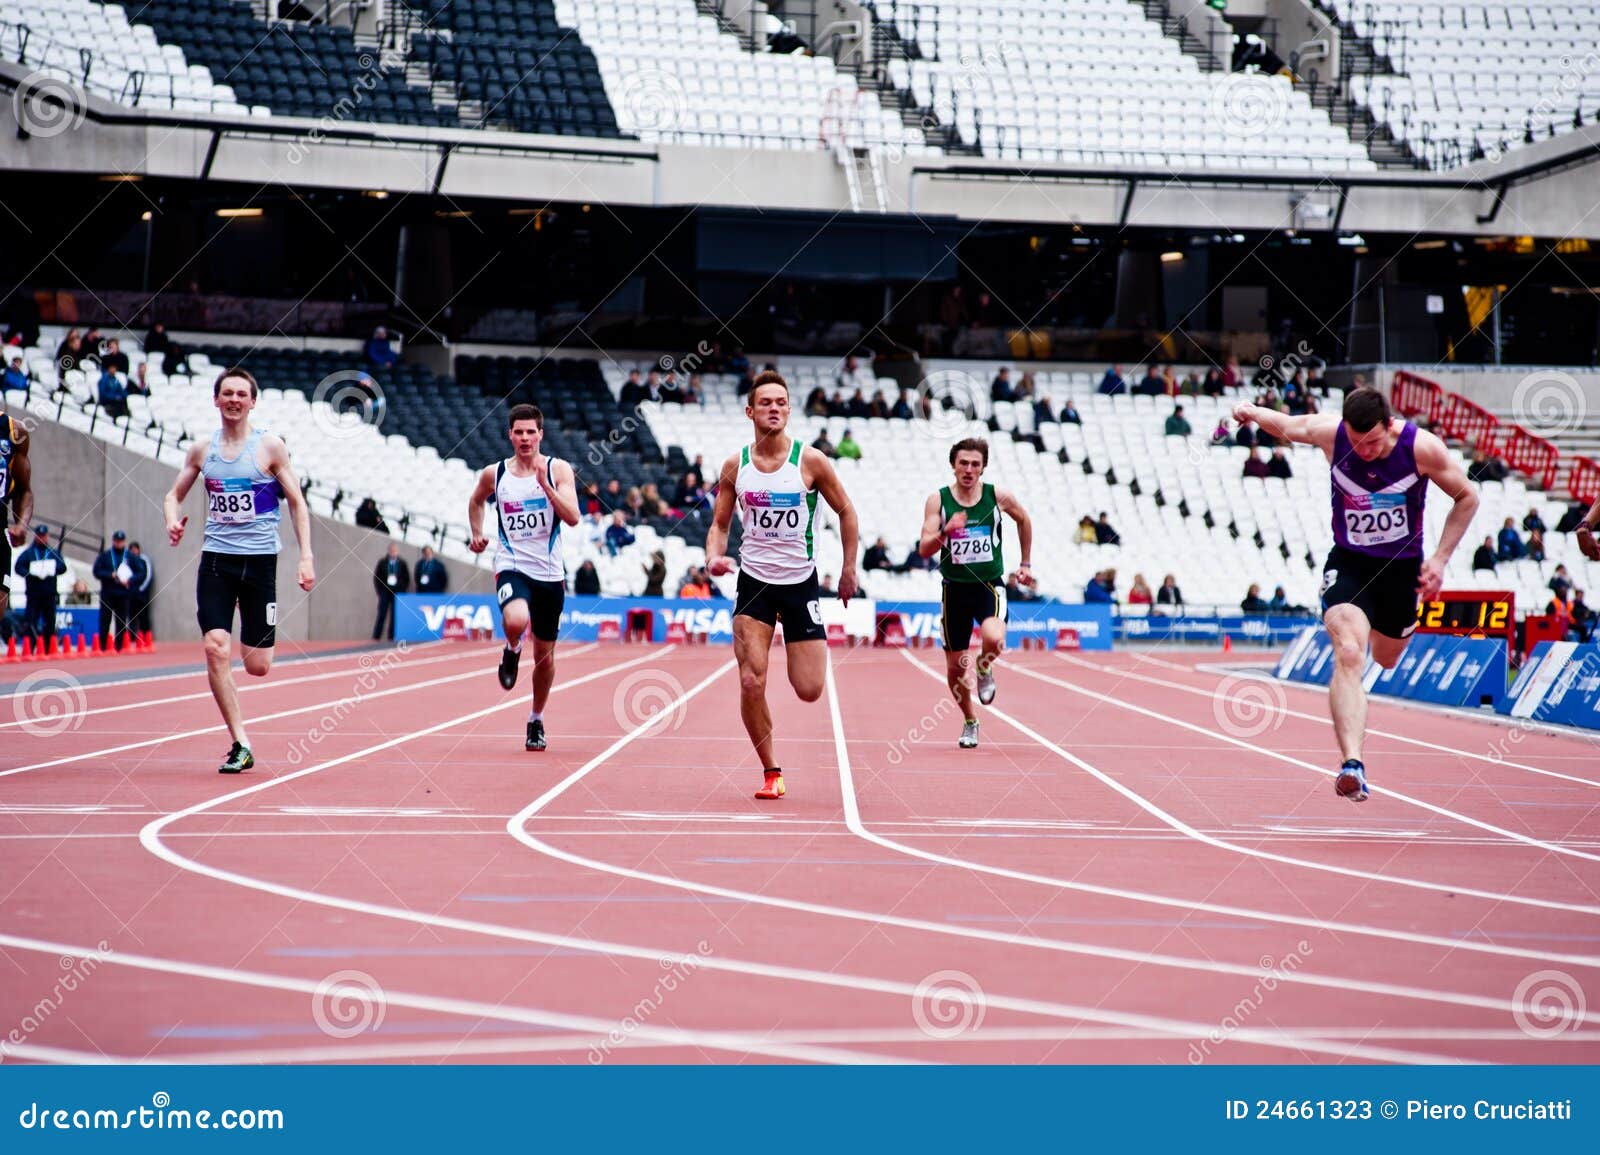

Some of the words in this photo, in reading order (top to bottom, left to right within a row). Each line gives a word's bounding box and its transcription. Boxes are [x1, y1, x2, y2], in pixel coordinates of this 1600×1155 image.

[210, 493, 253, 513] 2883
[506, 511, 546, 531] 2501
[751, 508, 799, 529] 1670
[1347, 508, 1406, 534] 2203
[952, 538, 991, 555] 2786
[419, 605, 494, 631] VISA
[660, 608, 732, 635] VISA
